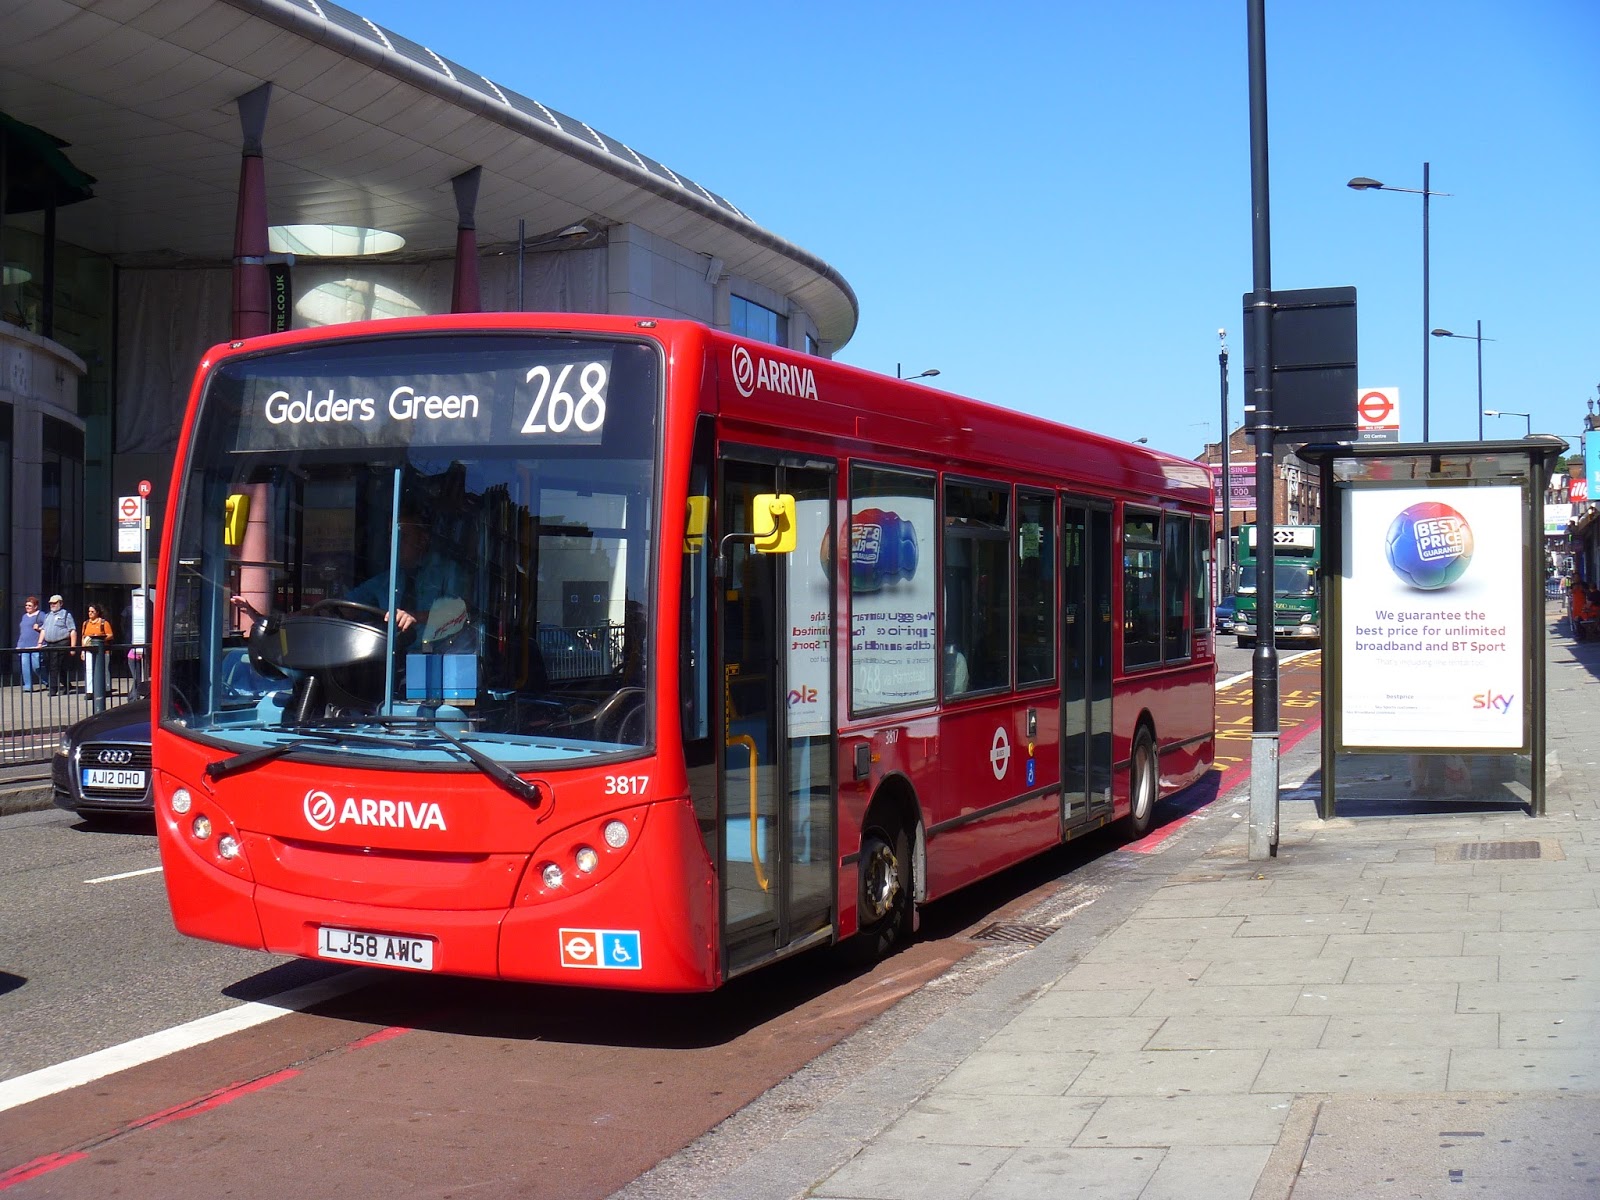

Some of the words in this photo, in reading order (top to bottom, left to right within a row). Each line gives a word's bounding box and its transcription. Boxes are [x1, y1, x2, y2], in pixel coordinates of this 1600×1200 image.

[276, 275, 285, 332] TRE.CO.UK
[757, 357, 819, 401] ARRIVA
[265, 389, 375, 424] Golders
[388, 386, 479, 420] Green
[520, 362, 607, 434] 268
[1417, 519, 1457, 537] BEST
[1420, 532, 1462, 550] PRICE
[1375, 610, 1394, 620] We
[1397, 611, 1461, 622] guarantee
[1464, 610, 1486, 620] the
[1356, 625, 1384, 636] best
[1387, 626, 1418, 638] price
[1422, 625, 1441, 636] for
[1445, 626, 1506, 636] unlimited
[1355, 641, 1422, 651] broadband
[1425, 641, 1448, 651] and
[1452, 642, 1467, 651] BT
[1470, 641, 1506, 654] Sport
[1473, 689, 1515, 715] sky
[885, 729, 899, 745] 3817
[92, 771, 115, 784] AJ12
[604, 775, 649, 795] 3817
[339, 797, 447, 831] ARRIVA
[326, 930, 378, 957] LJ58
[384, 938, 423, 963] AWC
